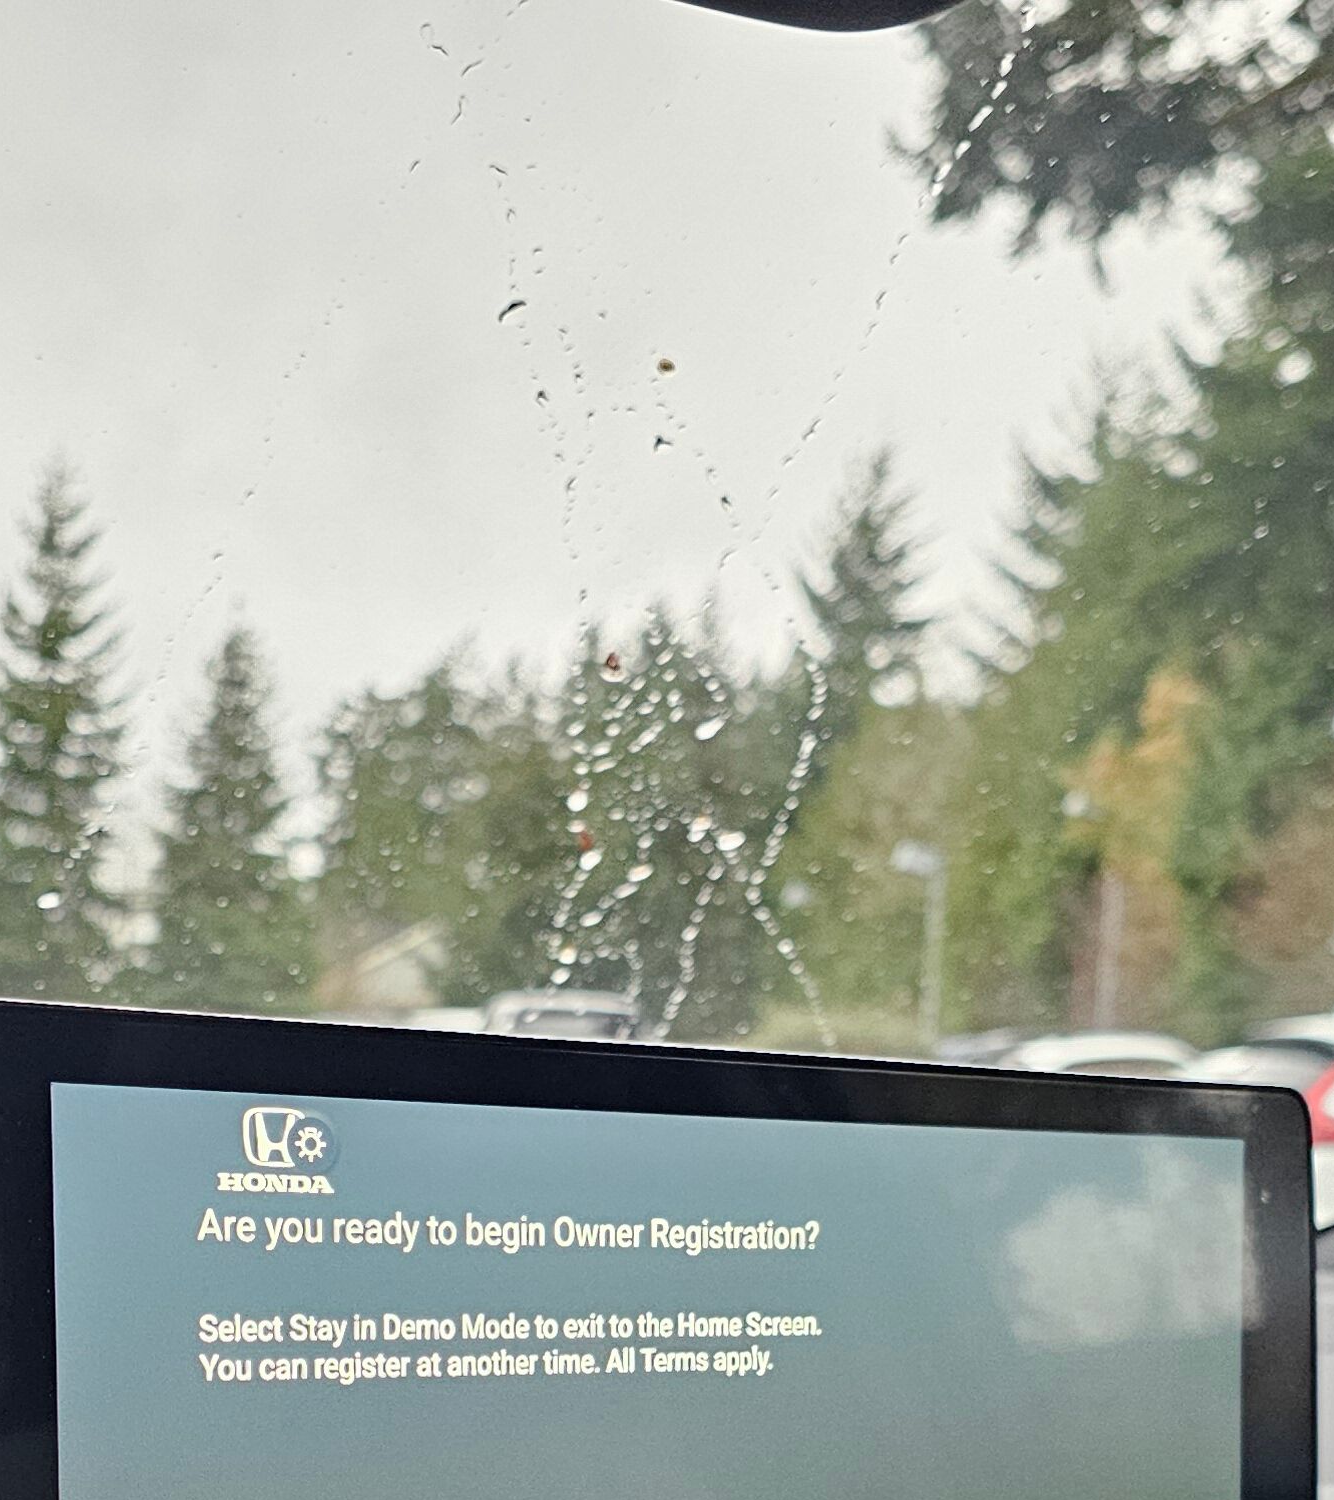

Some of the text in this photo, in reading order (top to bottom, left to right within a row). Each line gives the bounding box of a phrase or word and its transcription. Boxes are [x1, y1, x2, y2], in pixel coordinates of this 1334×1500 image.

[217, 1172, 335, 1194] HONDA
[197, 1208, 820, 1256] Are you ready to begin Owner Registration?
[198, 1311, 823, 1348] Select Stay in Demo Mode to exit to the Home Screen.
[199, 1345, 774, 1386] You can register at another time. All Terms apply.
